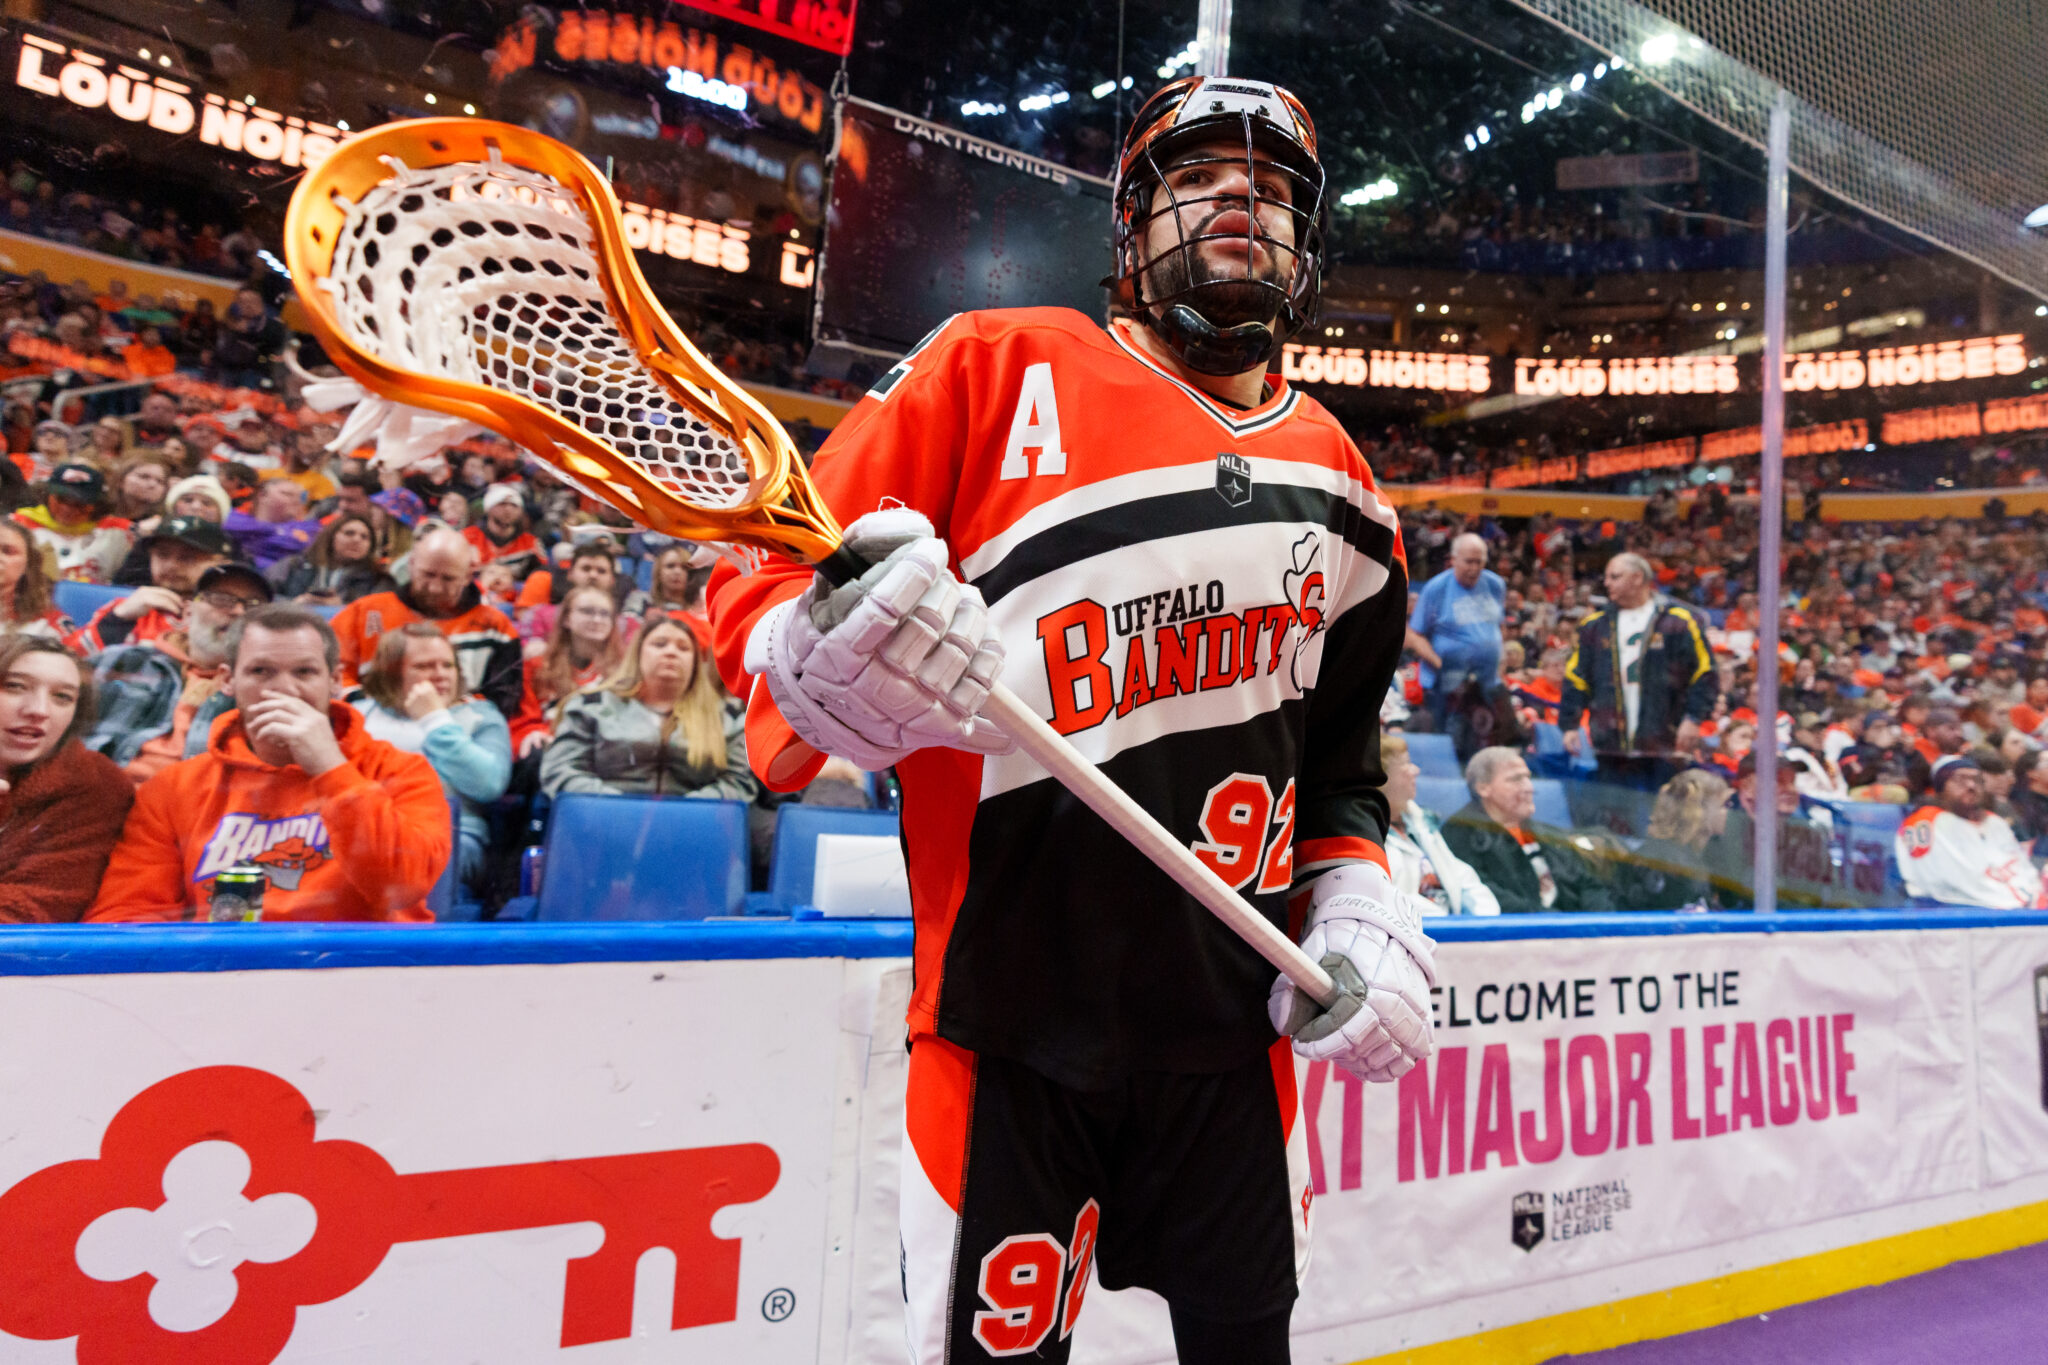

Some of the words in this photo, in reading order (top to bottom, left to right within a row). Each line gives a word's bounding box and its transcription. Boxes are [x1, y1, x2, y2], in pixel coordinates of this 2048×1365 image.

[16, 42, 195, 134] LOUD
[200, 101, 338, 170] NOIS
[622, 209, 750, 273] OISES
[1282, 350, 1368, 386] LOUD
[1369, 355, 1491, 393] NOISES
[1515, 365, 1607, 396] LOUD
[1608, 364, 1739, 395] NOISES
[1867, 343, 2027, 388] NOISES
[1000, 362, 1067, 481] A
[1220, 455, 1249, 474] NLL
[1037, 572, 1326, 737] BANDITS
[1430, 978, 1597, 1028] ELCOME
[1610, 976, 1661, 1015] TO
[1674, 970, 1740, 1009] THE
[1302, 1059, 1363, 1195] XT
[1398, 1032, 1654, 1183] MAJOR
[1671, 1013, 1858, 1141] LEAGUE
[1552, 1179, 1630, 1207] NATIONAL
[1553, 1193, 1633, 1225] LACROSSE
[1551, 1215, 1613, 1242] LEAGUE
[972, 1197, 1100, 1357] 92
